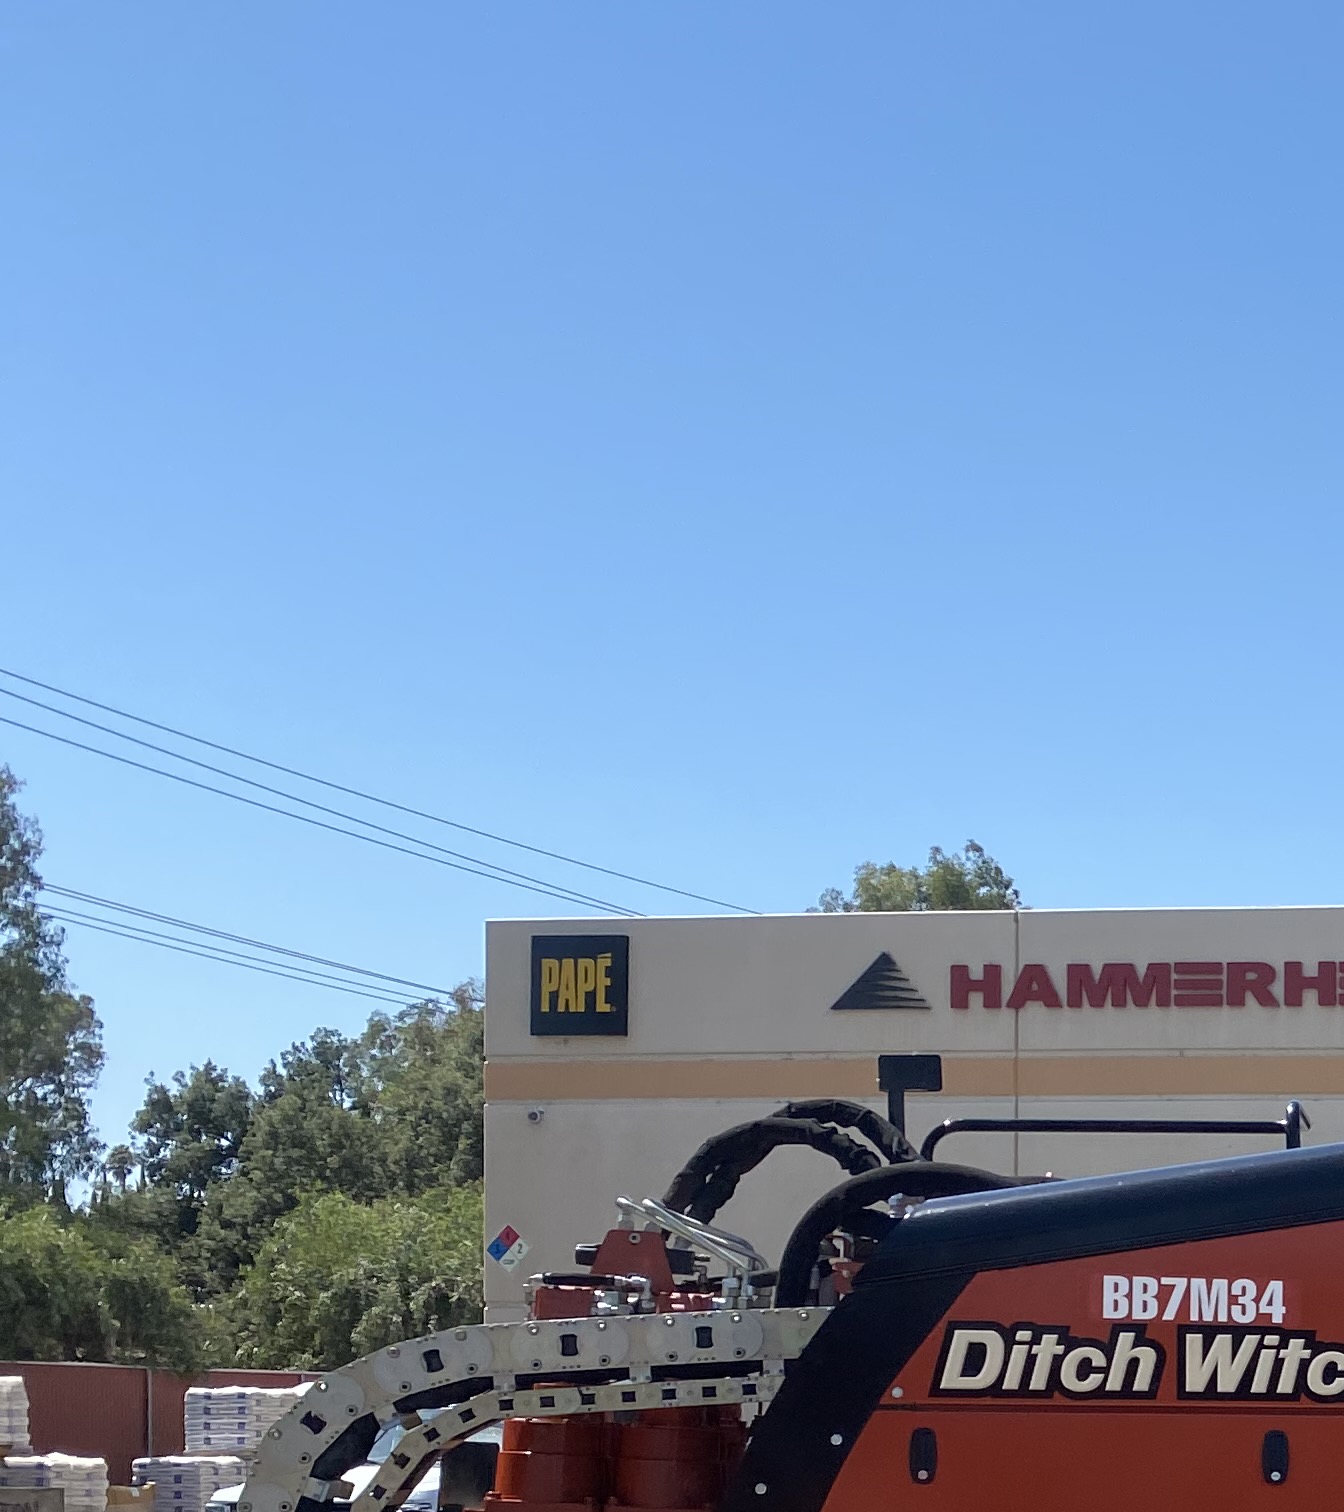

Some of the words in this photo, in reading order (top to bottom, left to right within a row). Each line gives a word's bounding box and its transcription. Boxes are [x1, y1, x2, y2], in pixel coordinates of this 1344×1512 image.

[541, 952, 612, 1012] PAPÉ
[1102, 1275, 1287, 1324] BB7M34
[938, 1328, 1158, 1393] Ditch
